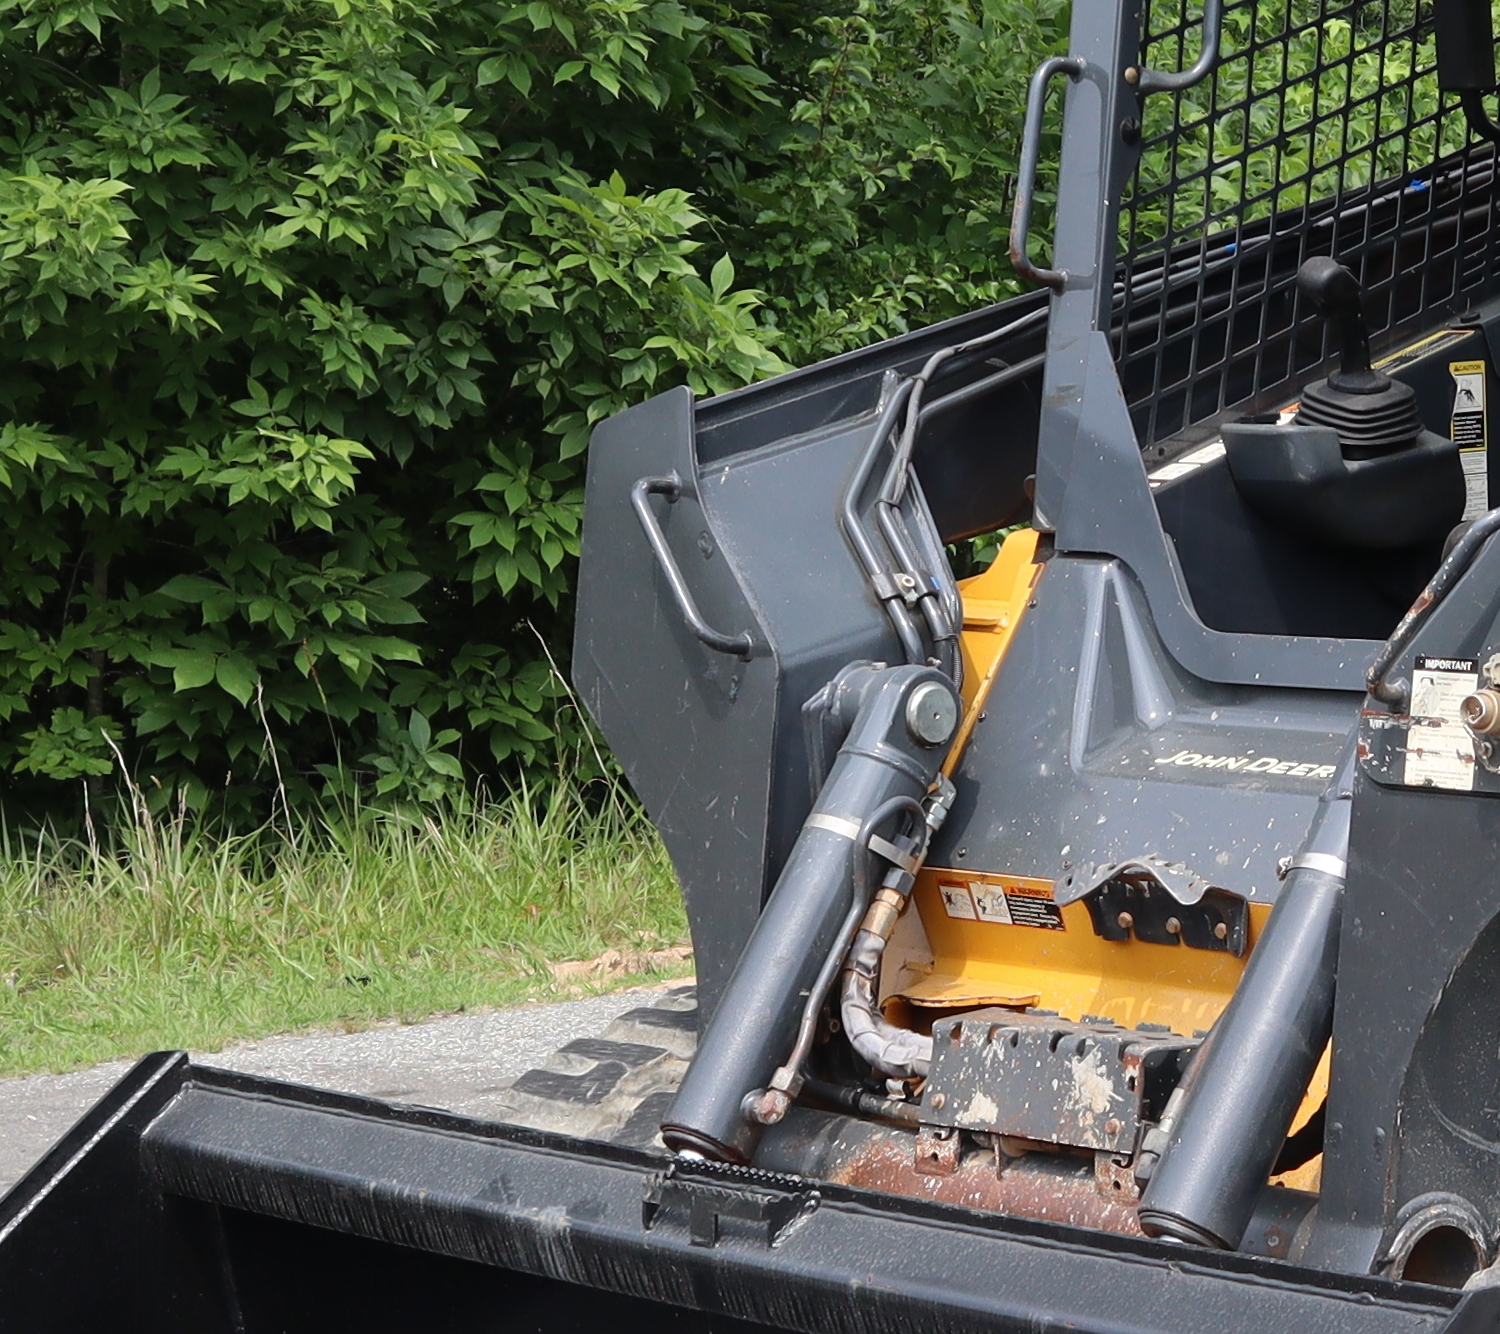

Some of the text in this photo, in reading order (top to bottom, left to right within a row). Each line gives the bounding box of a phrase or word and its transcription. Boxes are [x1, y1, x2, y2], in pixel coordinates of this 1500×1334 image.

[1424, 658, 1473, 671] IMPORTANT
[1154, 750, 1337, 778] JOHN DEER
